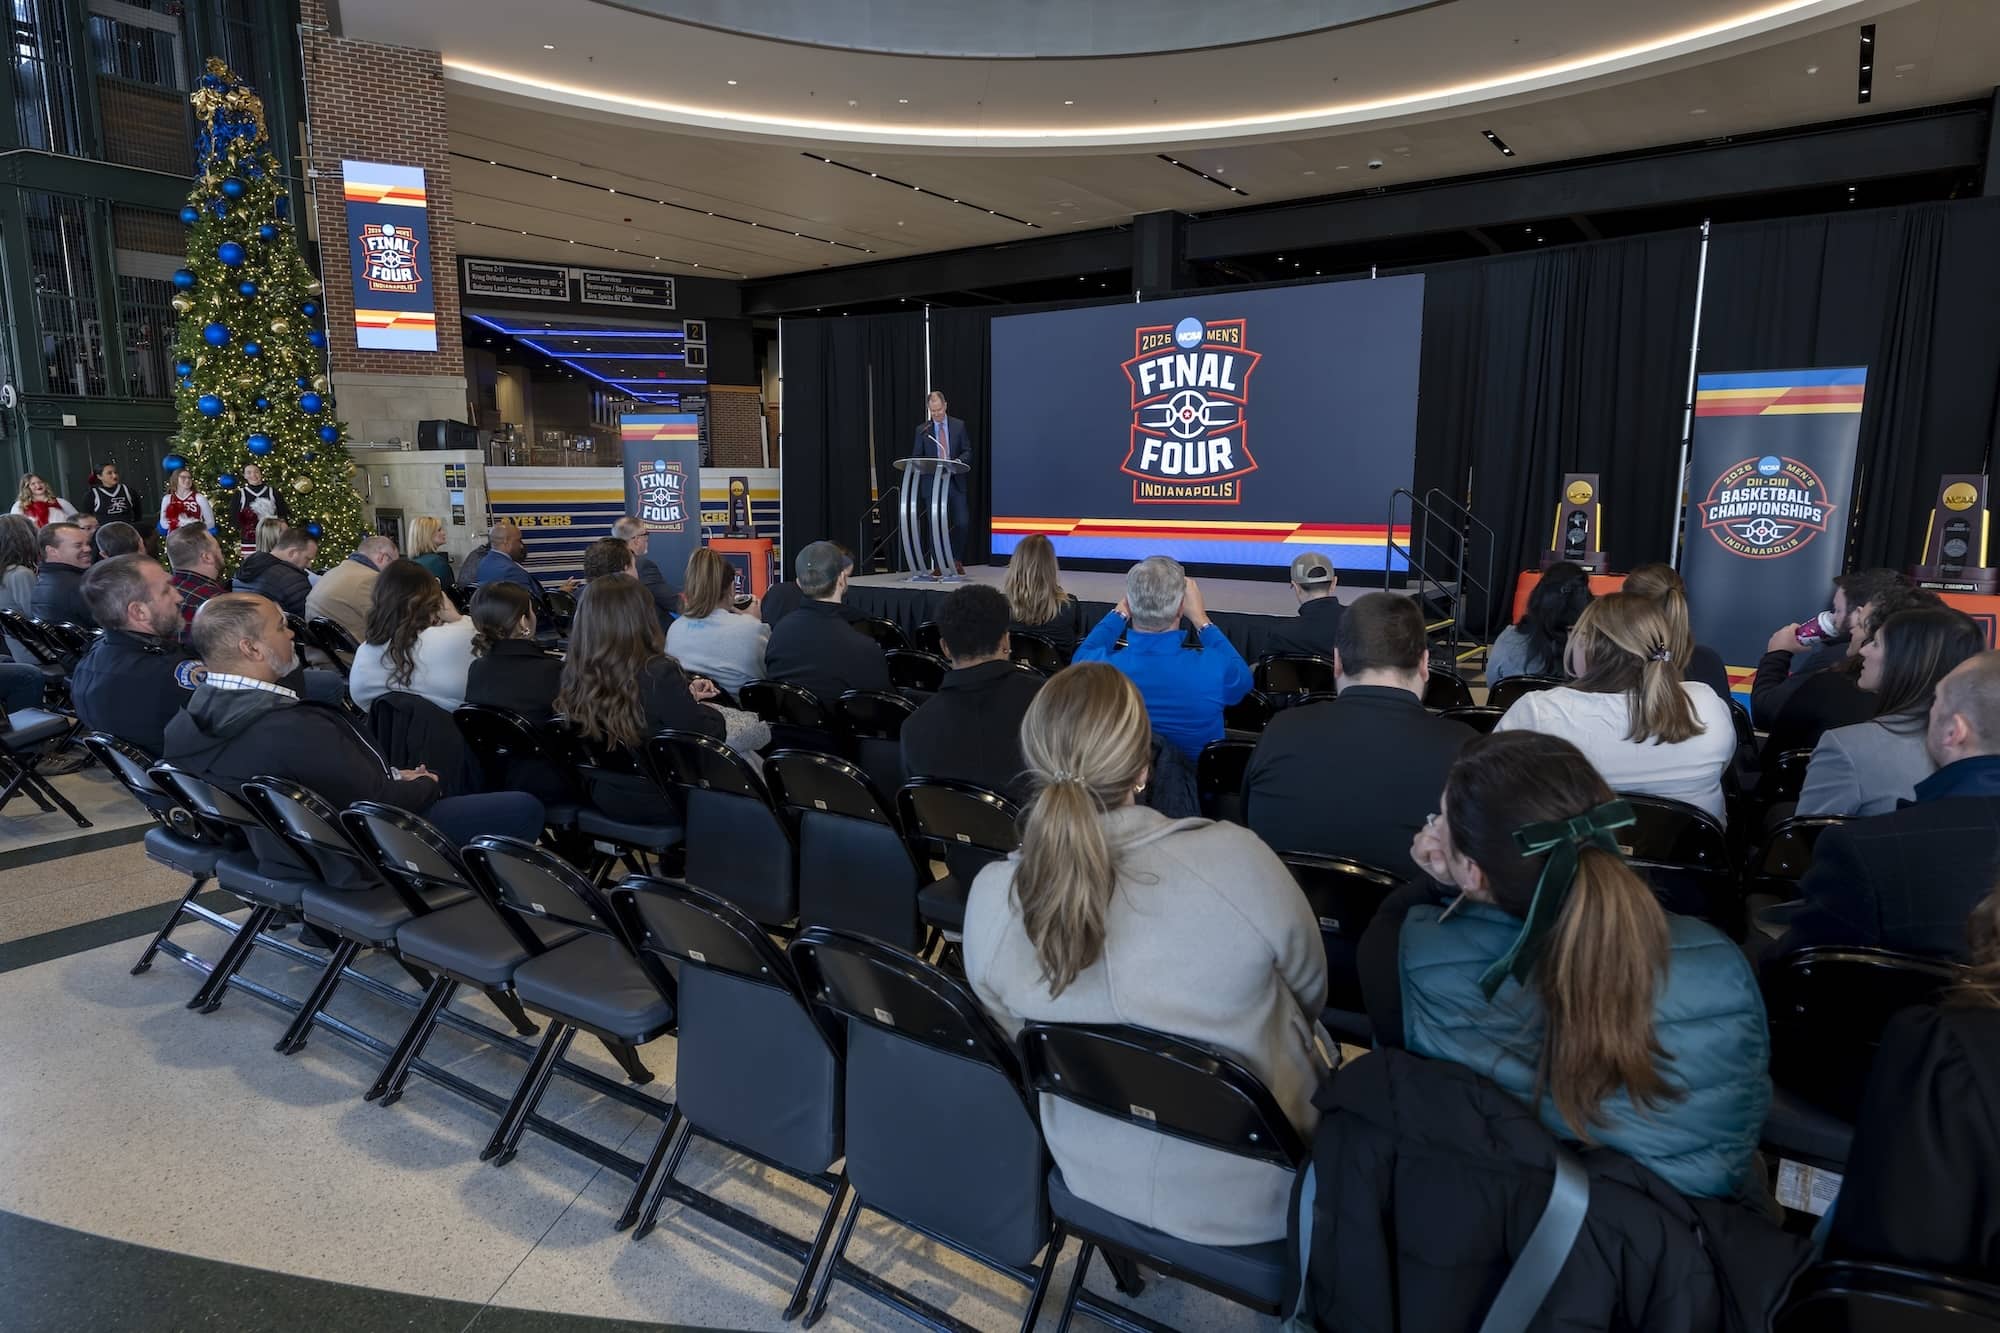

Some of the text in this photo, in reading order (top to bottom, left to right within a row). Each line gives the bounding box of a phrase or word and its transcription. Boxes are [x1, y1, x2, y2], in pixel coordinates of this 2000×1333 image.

[366, 237, 411, 253] FINAL
[371, 265, 413, 281] FOUR
[691, 325, 699, 338] 2
[1142, 328, 1239, 351] 2026 NCAA MEN'S
[694, 349, 698, 363] 1
[1138, 353, 1236, 395] FINAL
[1139, 436, 1234, 475] FOUR
[639, 473, 680, 489] FINAL
[1723, 464, 1753, 485] 2026
[1785, 463, 1816, 488] MEN'S
[1140, 481, 1233, 497] INDIANAPOLIS
[1720, 487, 1812, 505] BASKETBALL
[643, 505, 681, 521] FOUR
[1709, 502, 1822, 522] CHAMPIONSHIPS
[514, 515, 536, 527] YES
[1724, 536, 1799, 555] INDIANAPOLIS
